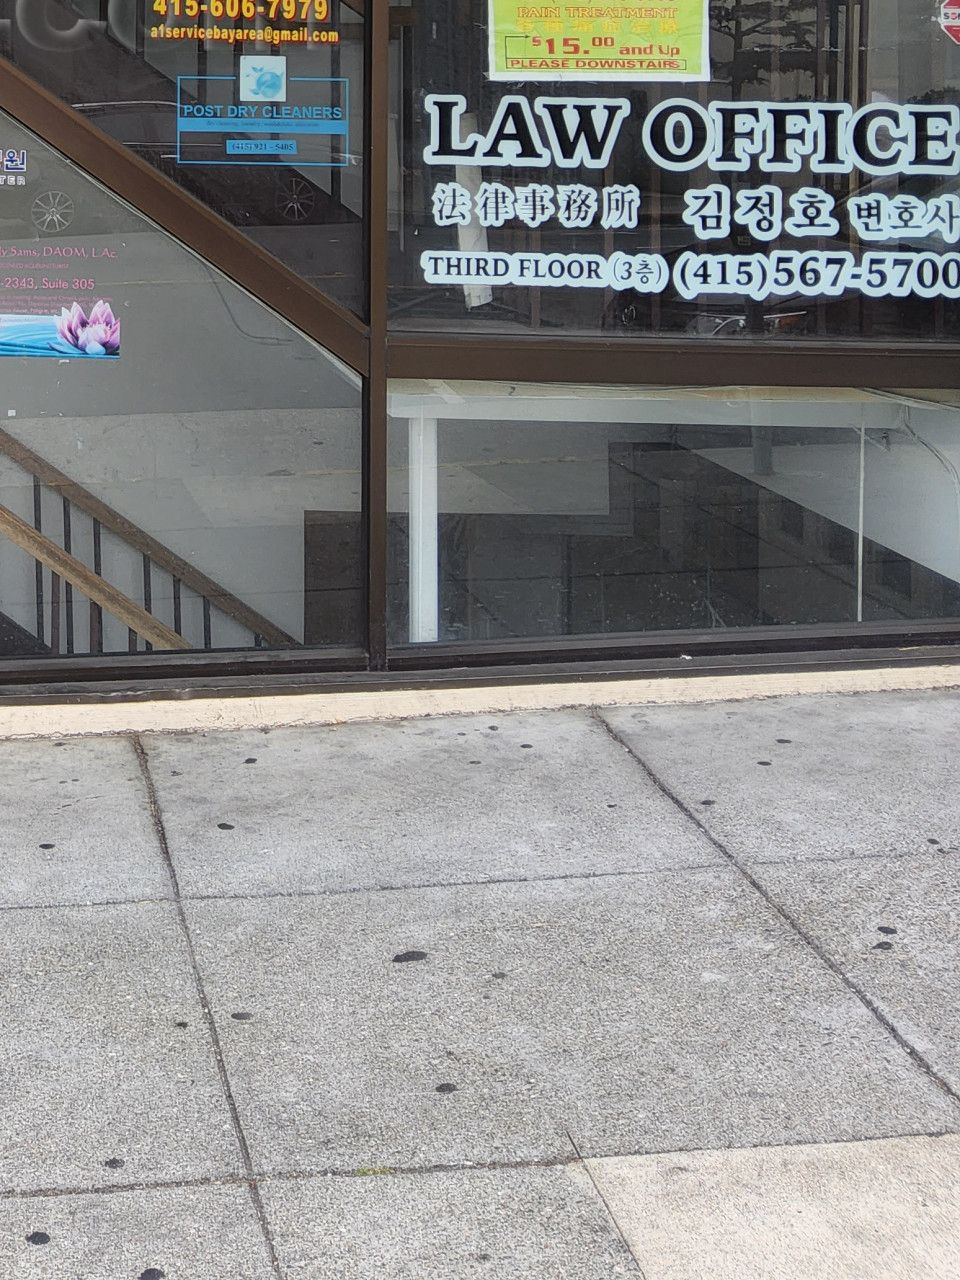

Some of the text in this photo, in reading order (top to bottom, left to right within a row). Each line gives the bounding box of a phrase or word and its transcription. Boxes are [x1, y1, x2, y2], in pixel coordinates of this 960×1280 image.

[517, 7, 678, 19] PAIN TREATMENT
[150, 24, 339, 45] a1servicebayarea@gmail.com
[619, 44, 653, 55] and
[511, 59, 681, 69] PLEASE DOWNSTAIRS
[184, 105, 342, 118] POST DRY CLEANERS
[427, 97, 958, 171] LAW OFFICE
[434, 184, 638, 226] 法律事務所
[426, 255, 511, 278] THIRD
[516, 256, 605, 281] FLOOR
[678, 255, 960, 293] (415)567-5700
[41, 277, 69, 289] Suite
[72, 278, 95, 290] 305
